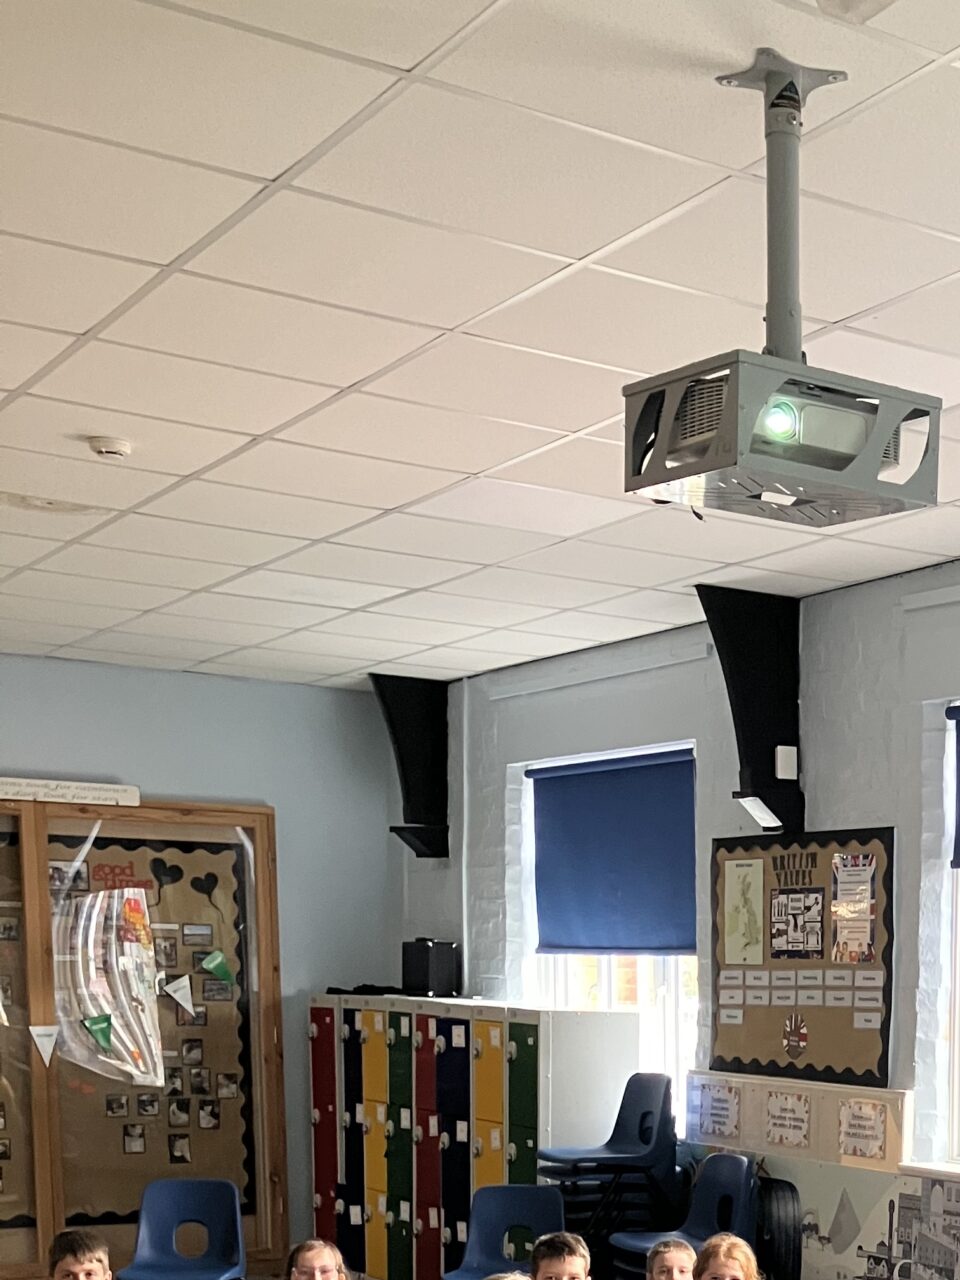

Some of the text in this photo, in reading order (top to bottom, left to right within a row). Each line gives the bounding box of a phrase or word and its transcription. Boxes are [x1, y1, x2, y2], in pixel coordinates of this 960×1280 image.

[92, 860, 135, 881] good
[772, 852, 818, 871] BRITISH
[776, 870, 813, 887] VALUES
